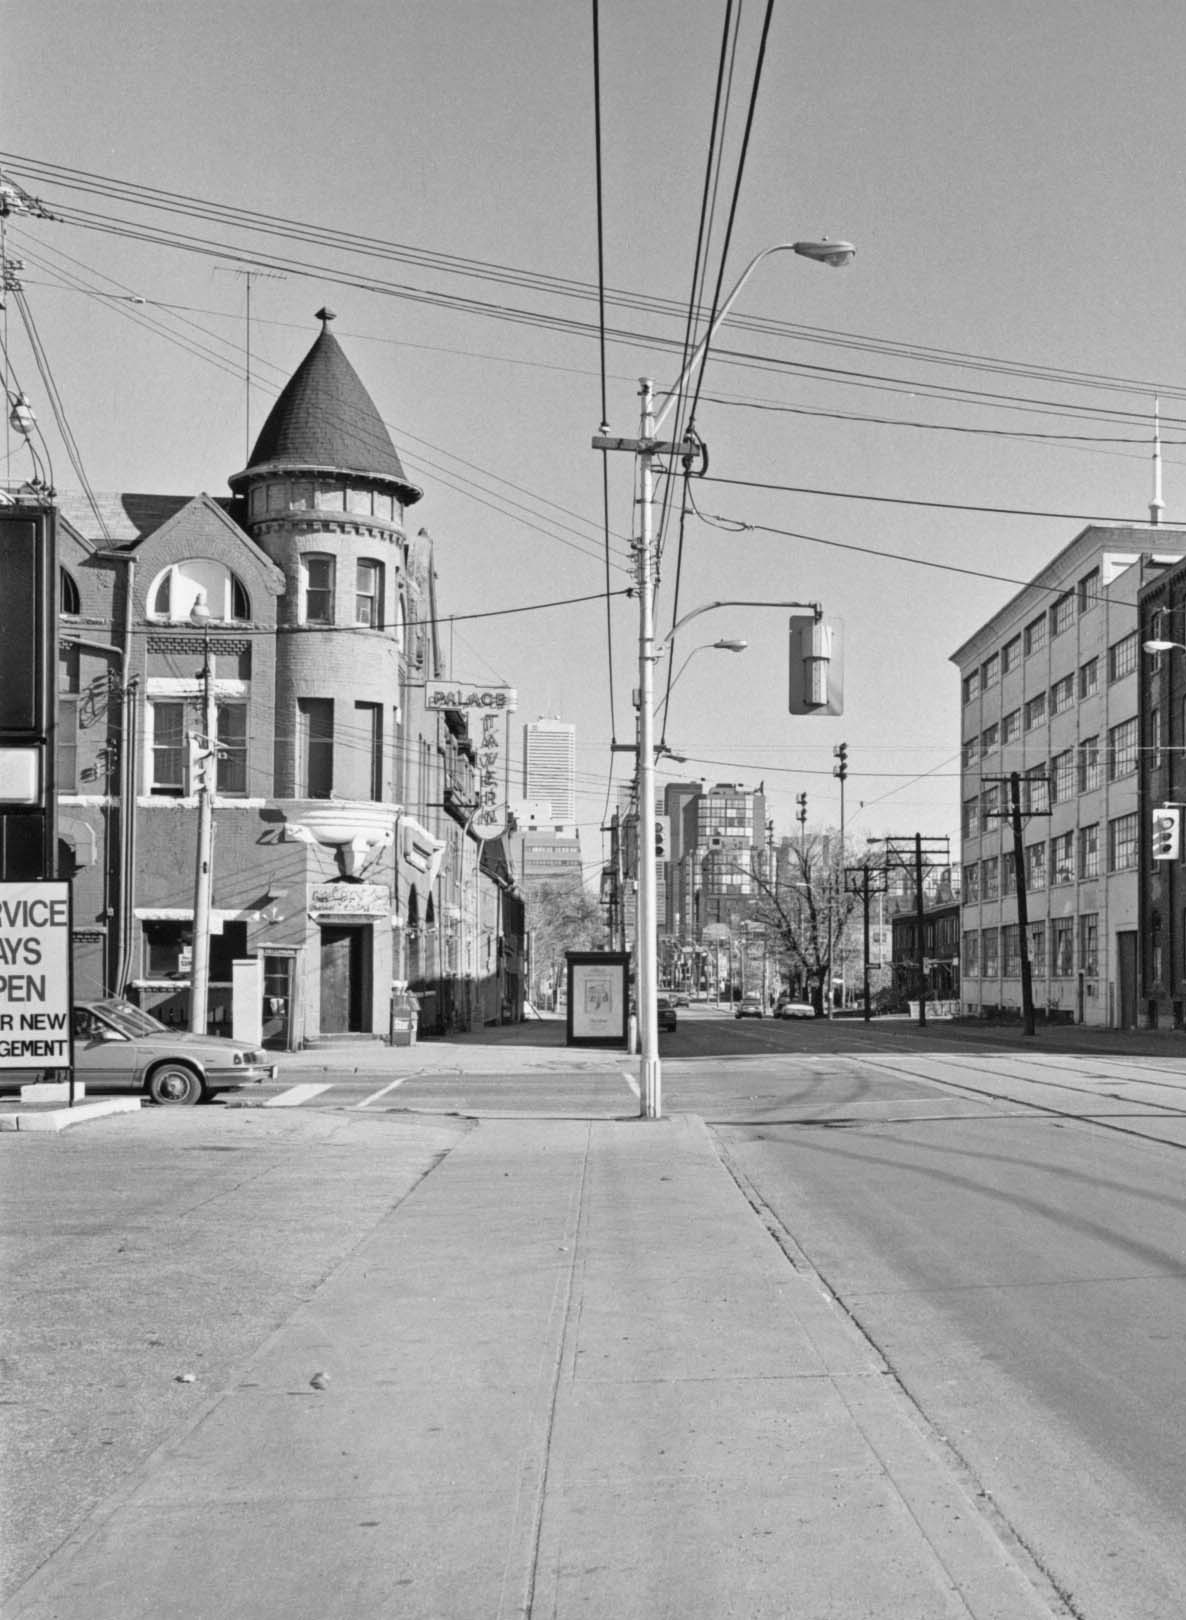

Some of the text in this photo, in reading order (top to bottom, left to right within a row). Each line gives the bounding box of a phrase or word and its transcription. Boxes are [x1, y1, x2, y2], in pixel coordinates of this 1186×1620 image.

[433, 689, 507, 708] PALACE
[480, 713, 499, 824] TAVERN
[0, 899, 68, 928] VICE
[20, 1013, 67, 1031] NEW
